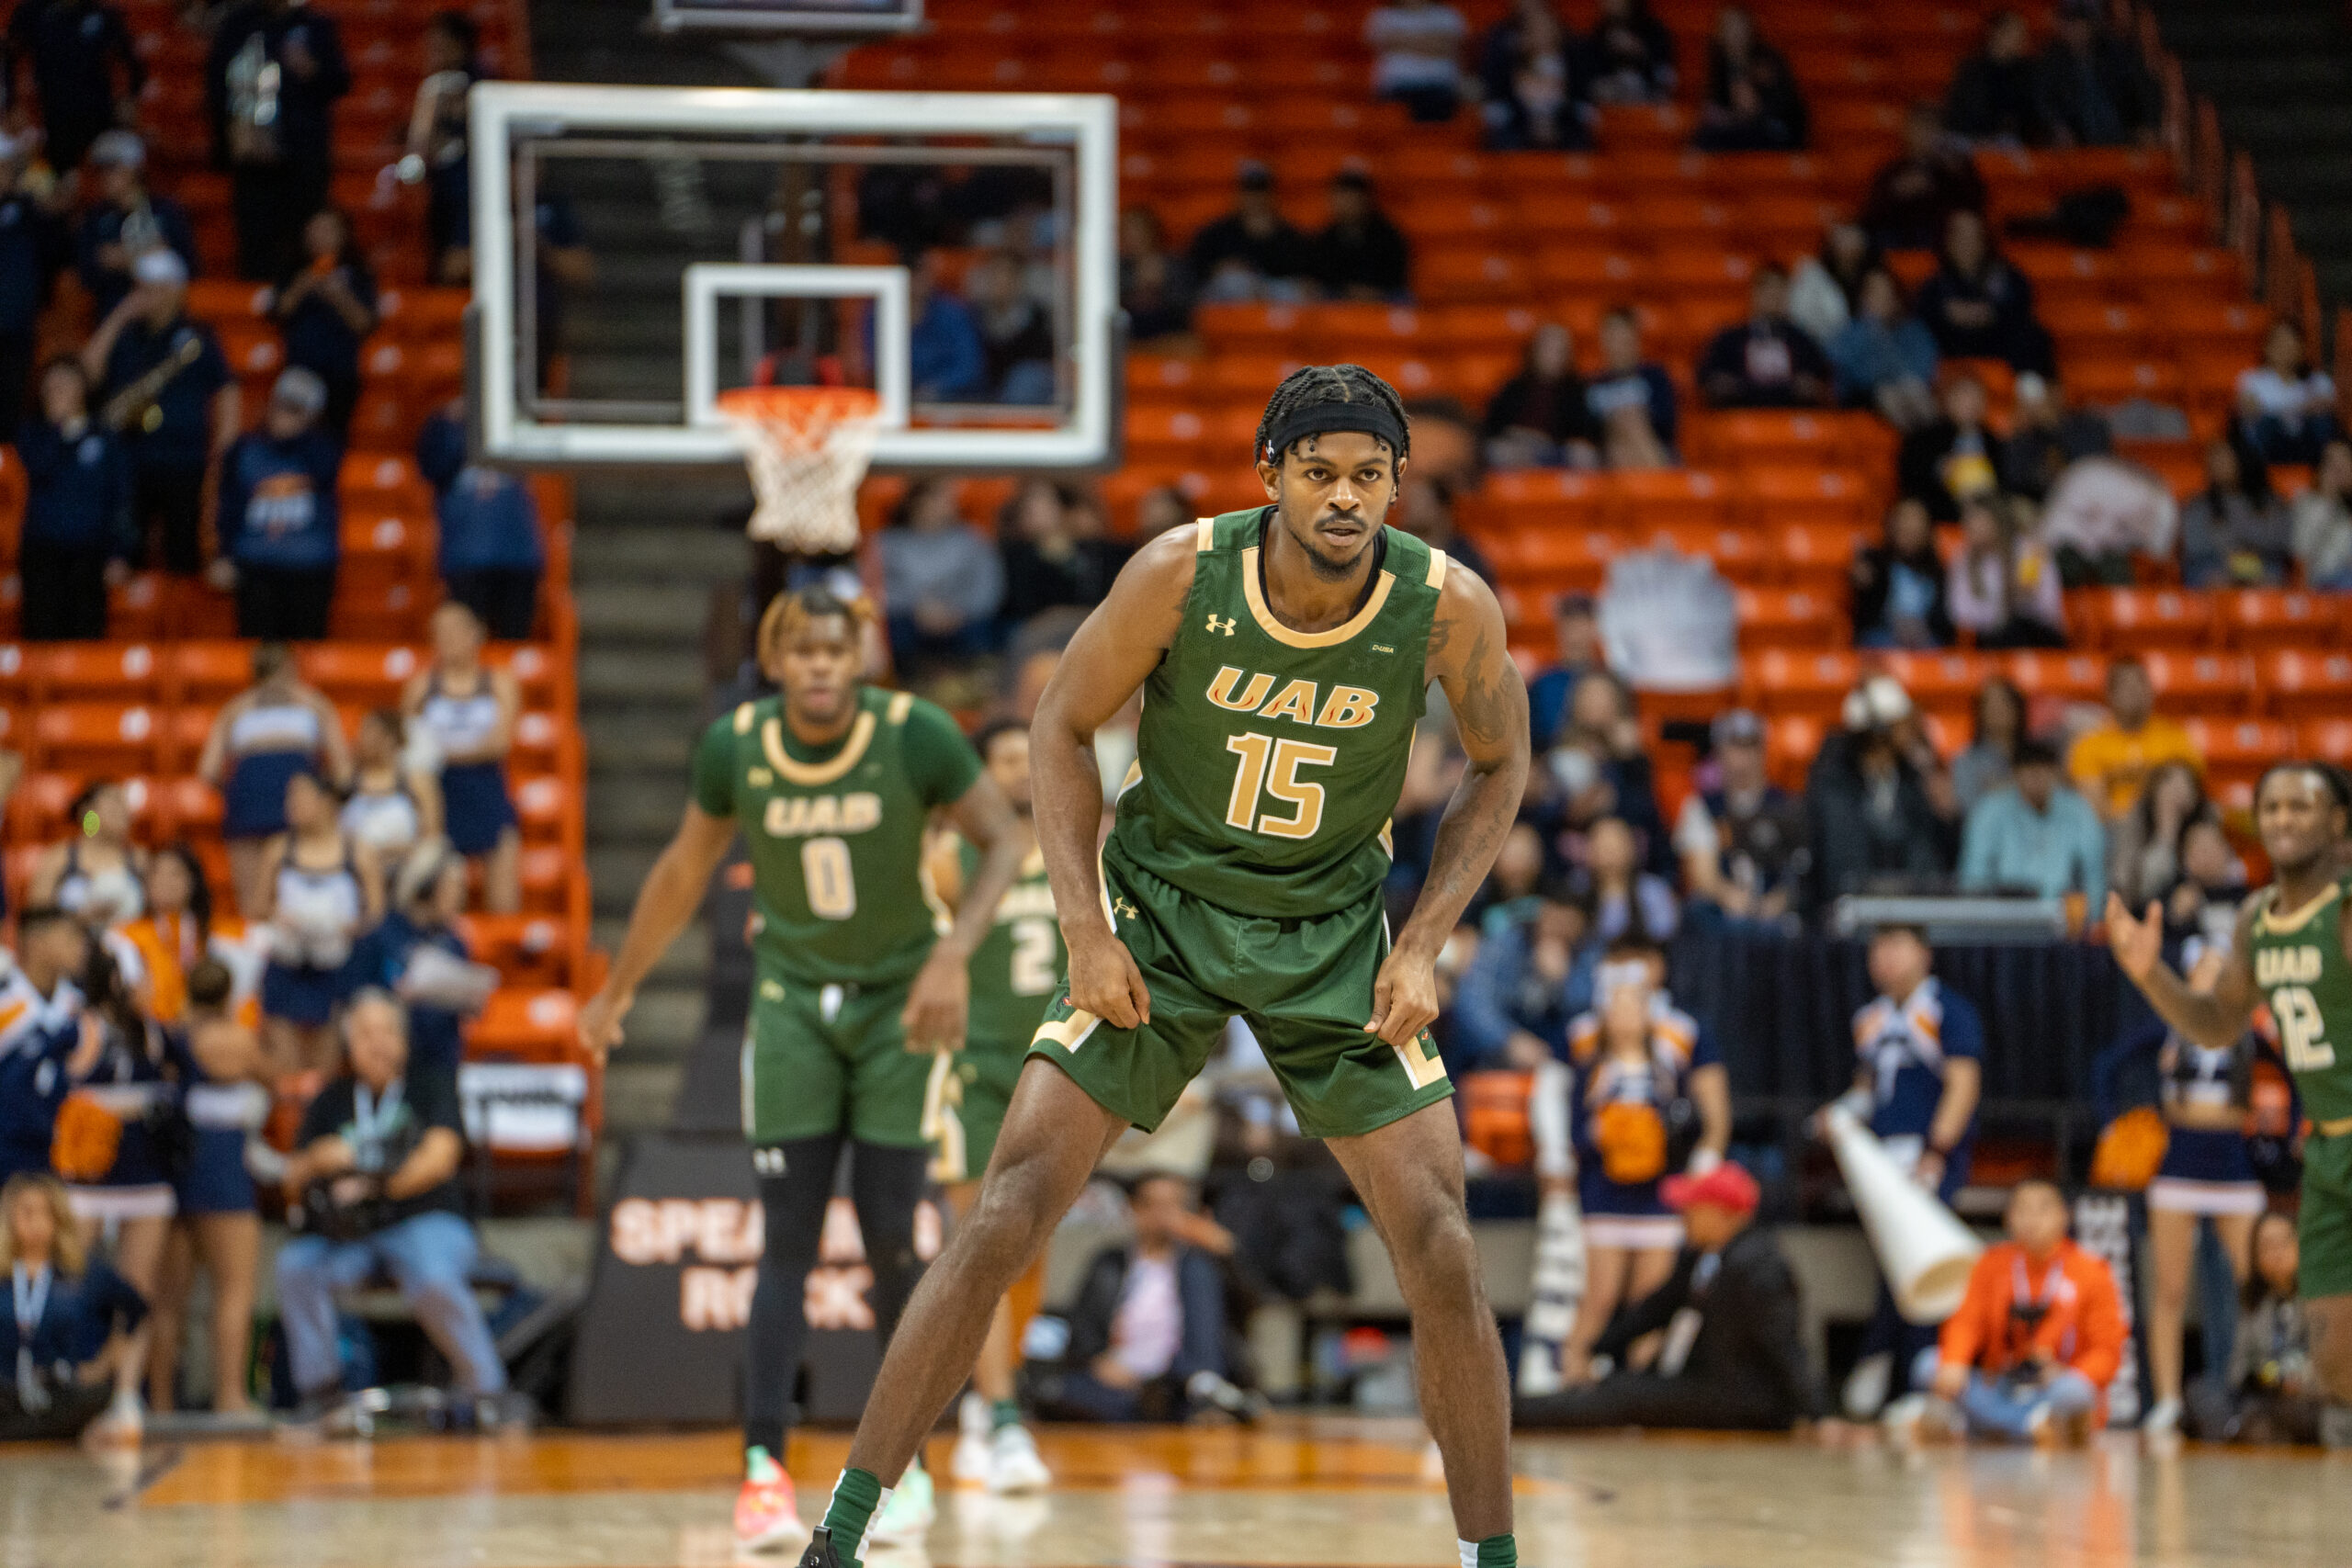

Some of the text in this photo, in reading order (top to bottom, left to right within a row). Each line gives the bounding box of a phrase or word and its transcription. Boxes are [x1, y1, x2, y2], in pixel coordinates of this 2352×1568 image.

[1205, 664, 1380, 728] UAB
[763, 792, 882, 838] UAB
[1226, 731, 1338, 840] 15
[801, 836, 857, 920] 0
[1012, 919, 1057, 996] 2
[2256, 945, 2323, 987] UAB
[2272, 987, 2335, 1071] 12
